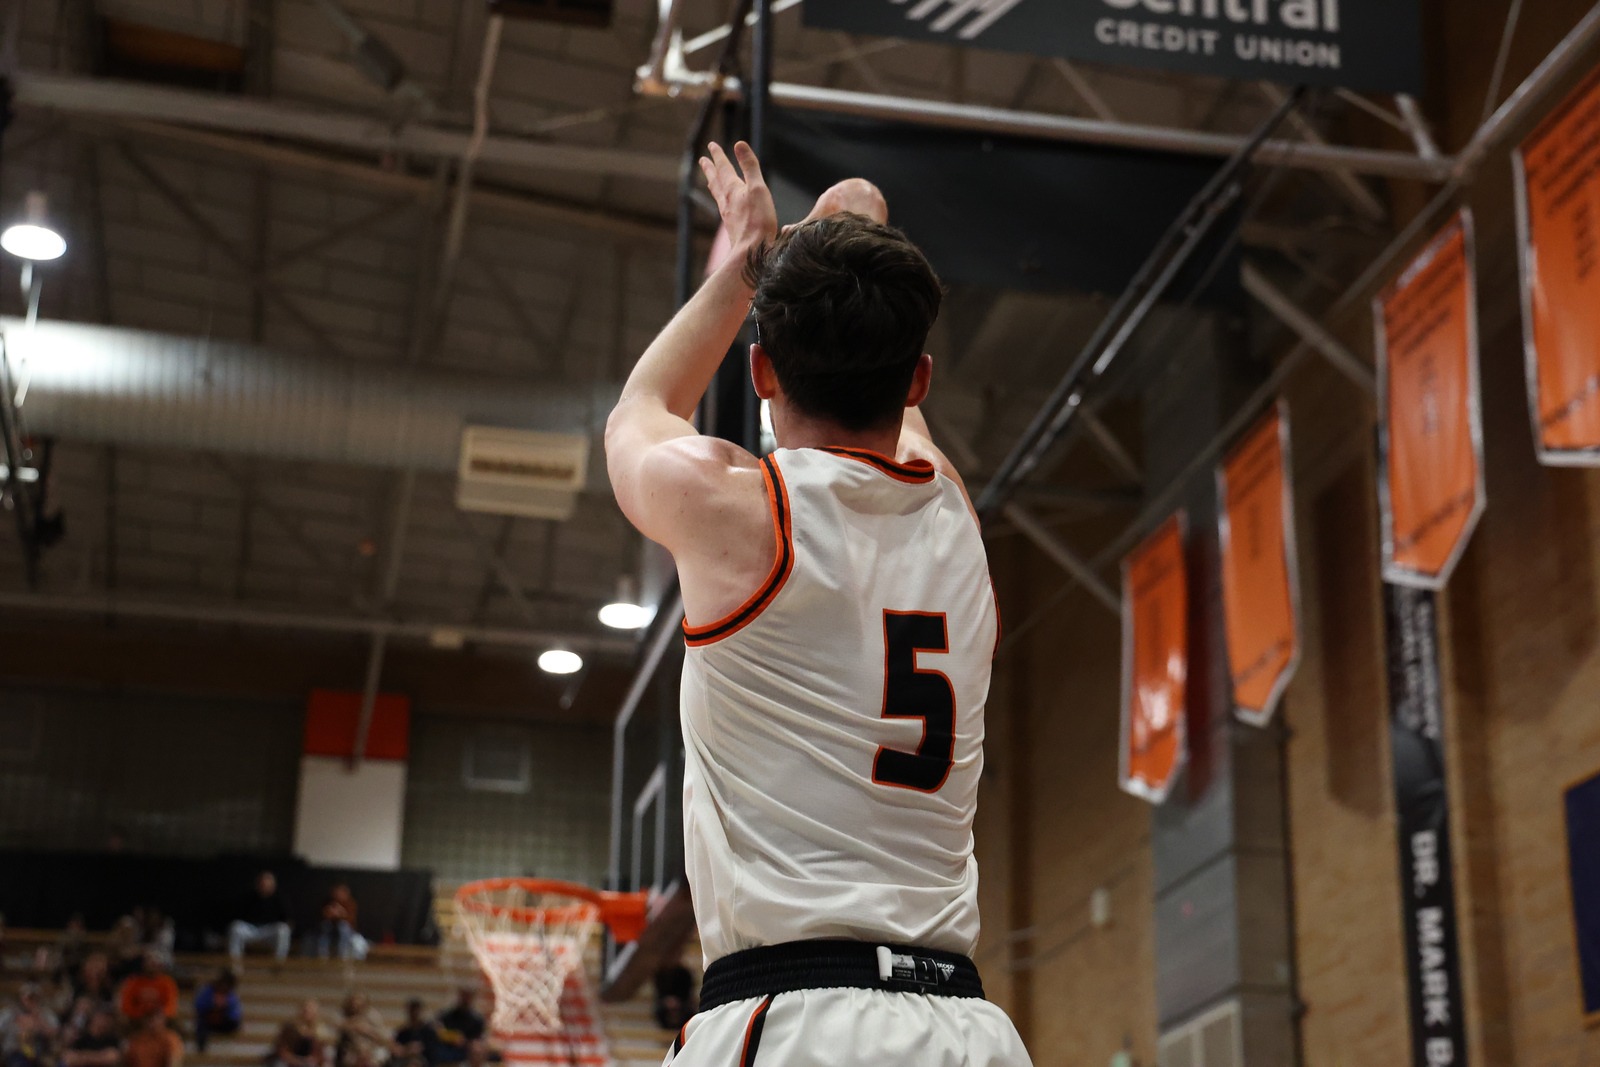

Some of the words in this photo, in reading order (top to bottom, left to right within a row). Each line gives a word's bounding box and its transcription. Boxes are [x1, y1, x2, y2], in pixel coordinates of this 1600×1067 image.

[1095, 18, 1219, 55] CREDIT
[1234, 33, 1341, 69] UNION
[872, 608, 956, 793] 5
[1411, 830, 1440, 898] DR.
[1416, 907, 1450, 1026] MARK
